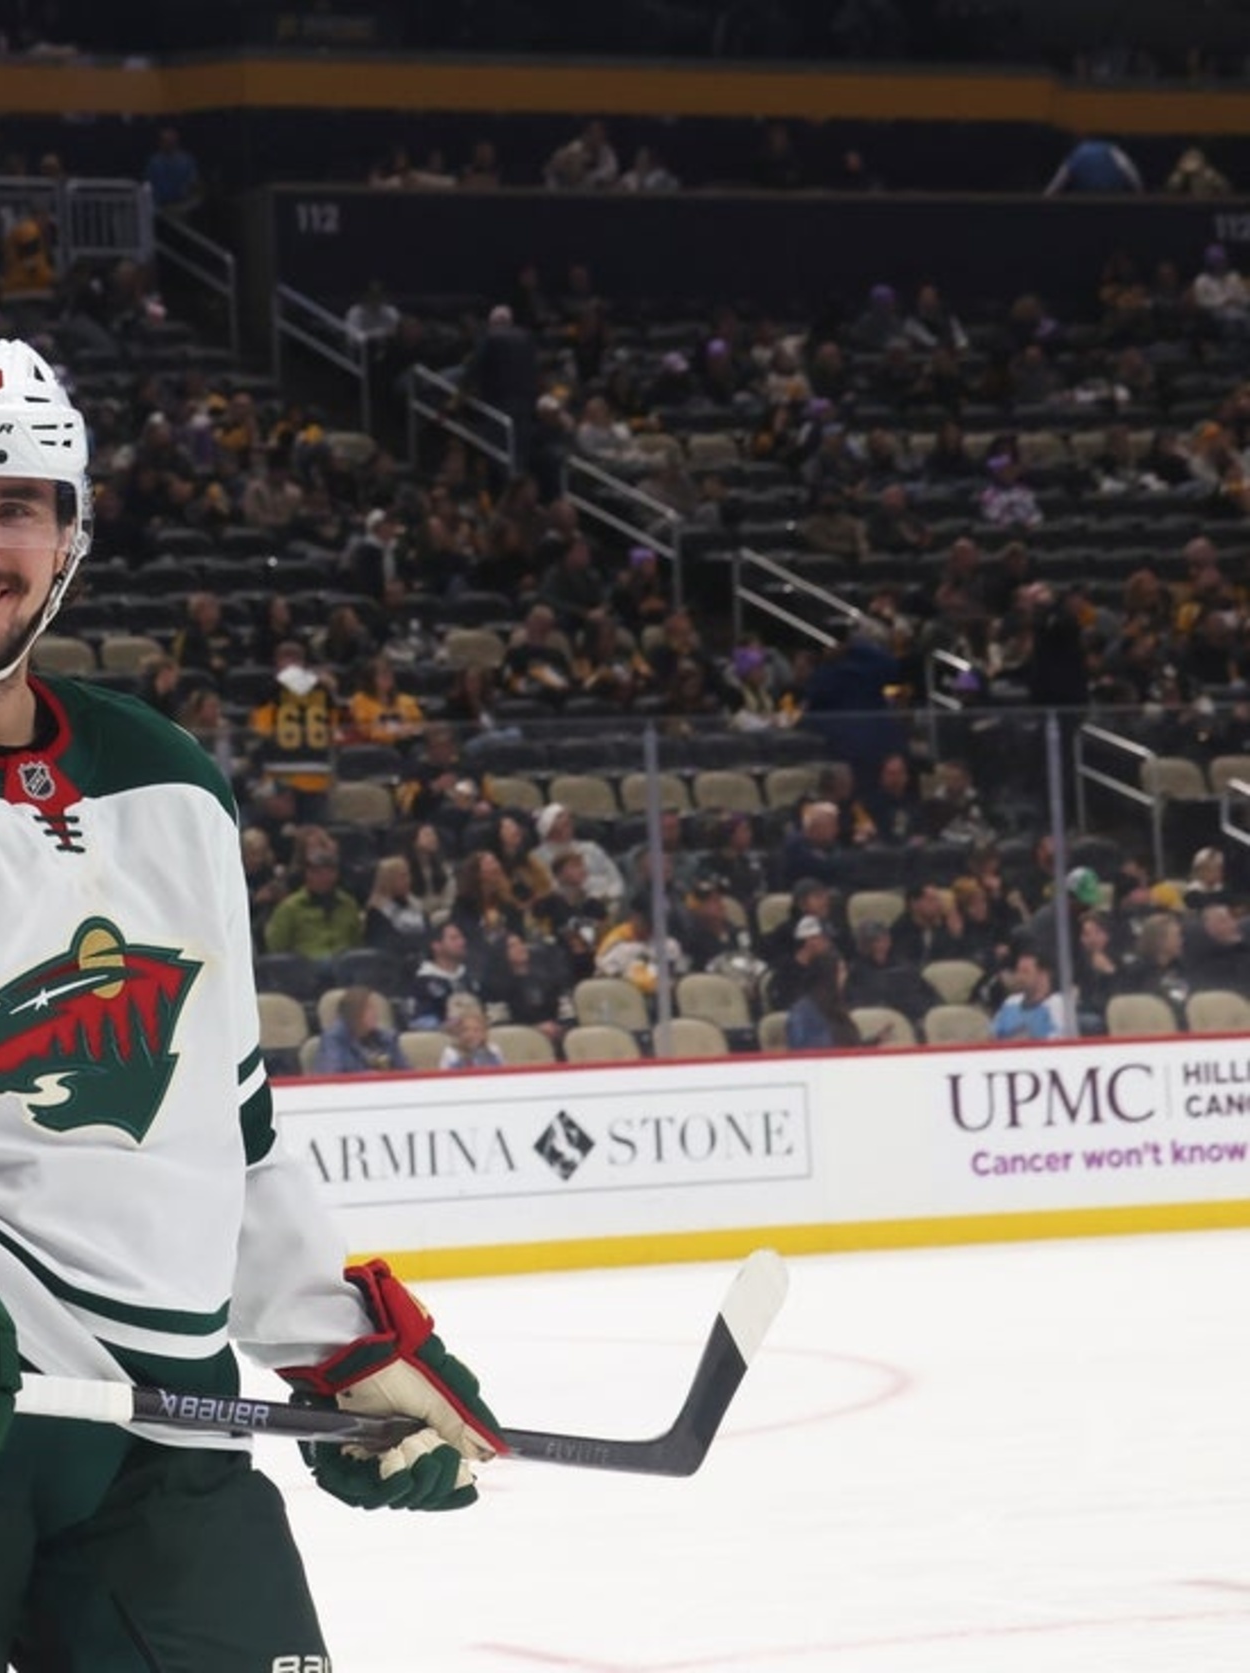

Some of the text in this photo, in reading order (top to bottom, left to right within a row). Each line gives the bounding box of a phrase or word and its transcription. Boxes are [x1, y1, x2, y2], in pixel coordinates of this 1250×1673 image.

[277, 702, 328, 750] 66
[1182, 1059, 1250, 1086] HILL
[946, 1063, 1155, 1132] UPMC
[307, 1110, 794, 1184] ARMINA STONE
[970, 1138, 1248, 1177] Cancer won't know
